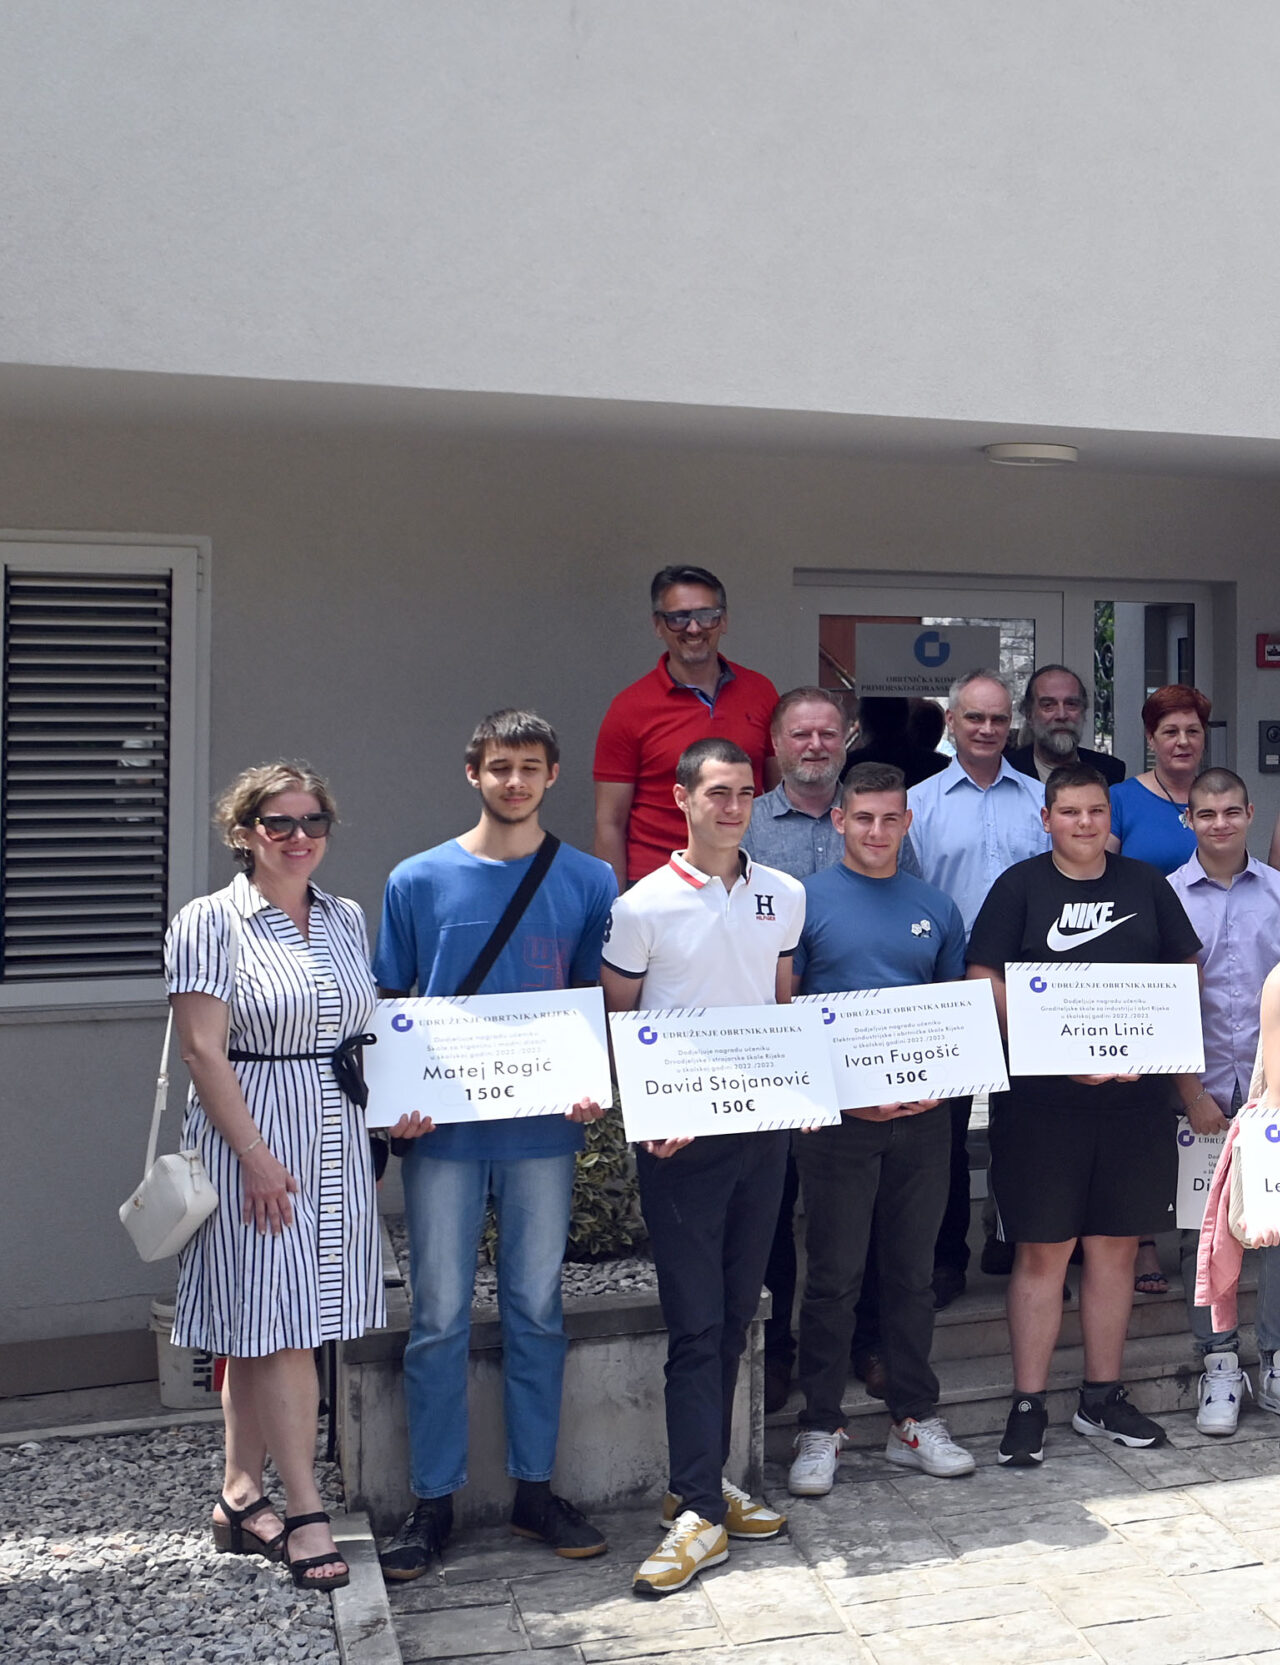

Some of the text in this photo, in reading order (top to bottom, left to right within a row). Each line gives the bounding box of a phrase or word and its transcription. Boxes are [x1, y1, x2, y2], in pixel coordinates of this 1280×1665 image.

[754, 894, 776, 916] H
[1059, 902, 1115, 929] NIKE
[1051, 981, 1101, 989] UDRUŽENJE
[840, 1000, 972, 1019] UDRUŽENJE OBRTNIKA RIJEKA
[662, 1025, 802, 1039] UDRUŽENJE OBRTNIKA RIJEKA
[1060, 1023, 1155, 1036] Arian Linić
[845, 1043, 960, 1068] Ivan Fugošić
[1089, 1045, 1129, 1057] 150€
[423, 1057, 552, 1081] Matej Rogić
[885, 1069, 928, 1085] 150€
[645, 1071, 810, 1095] David Stojanović
[465, 1085, 515, 1101] 150€
[711, 1099, 756, 1114] 150€
[1193, 1178, 1210, 1191] Di
